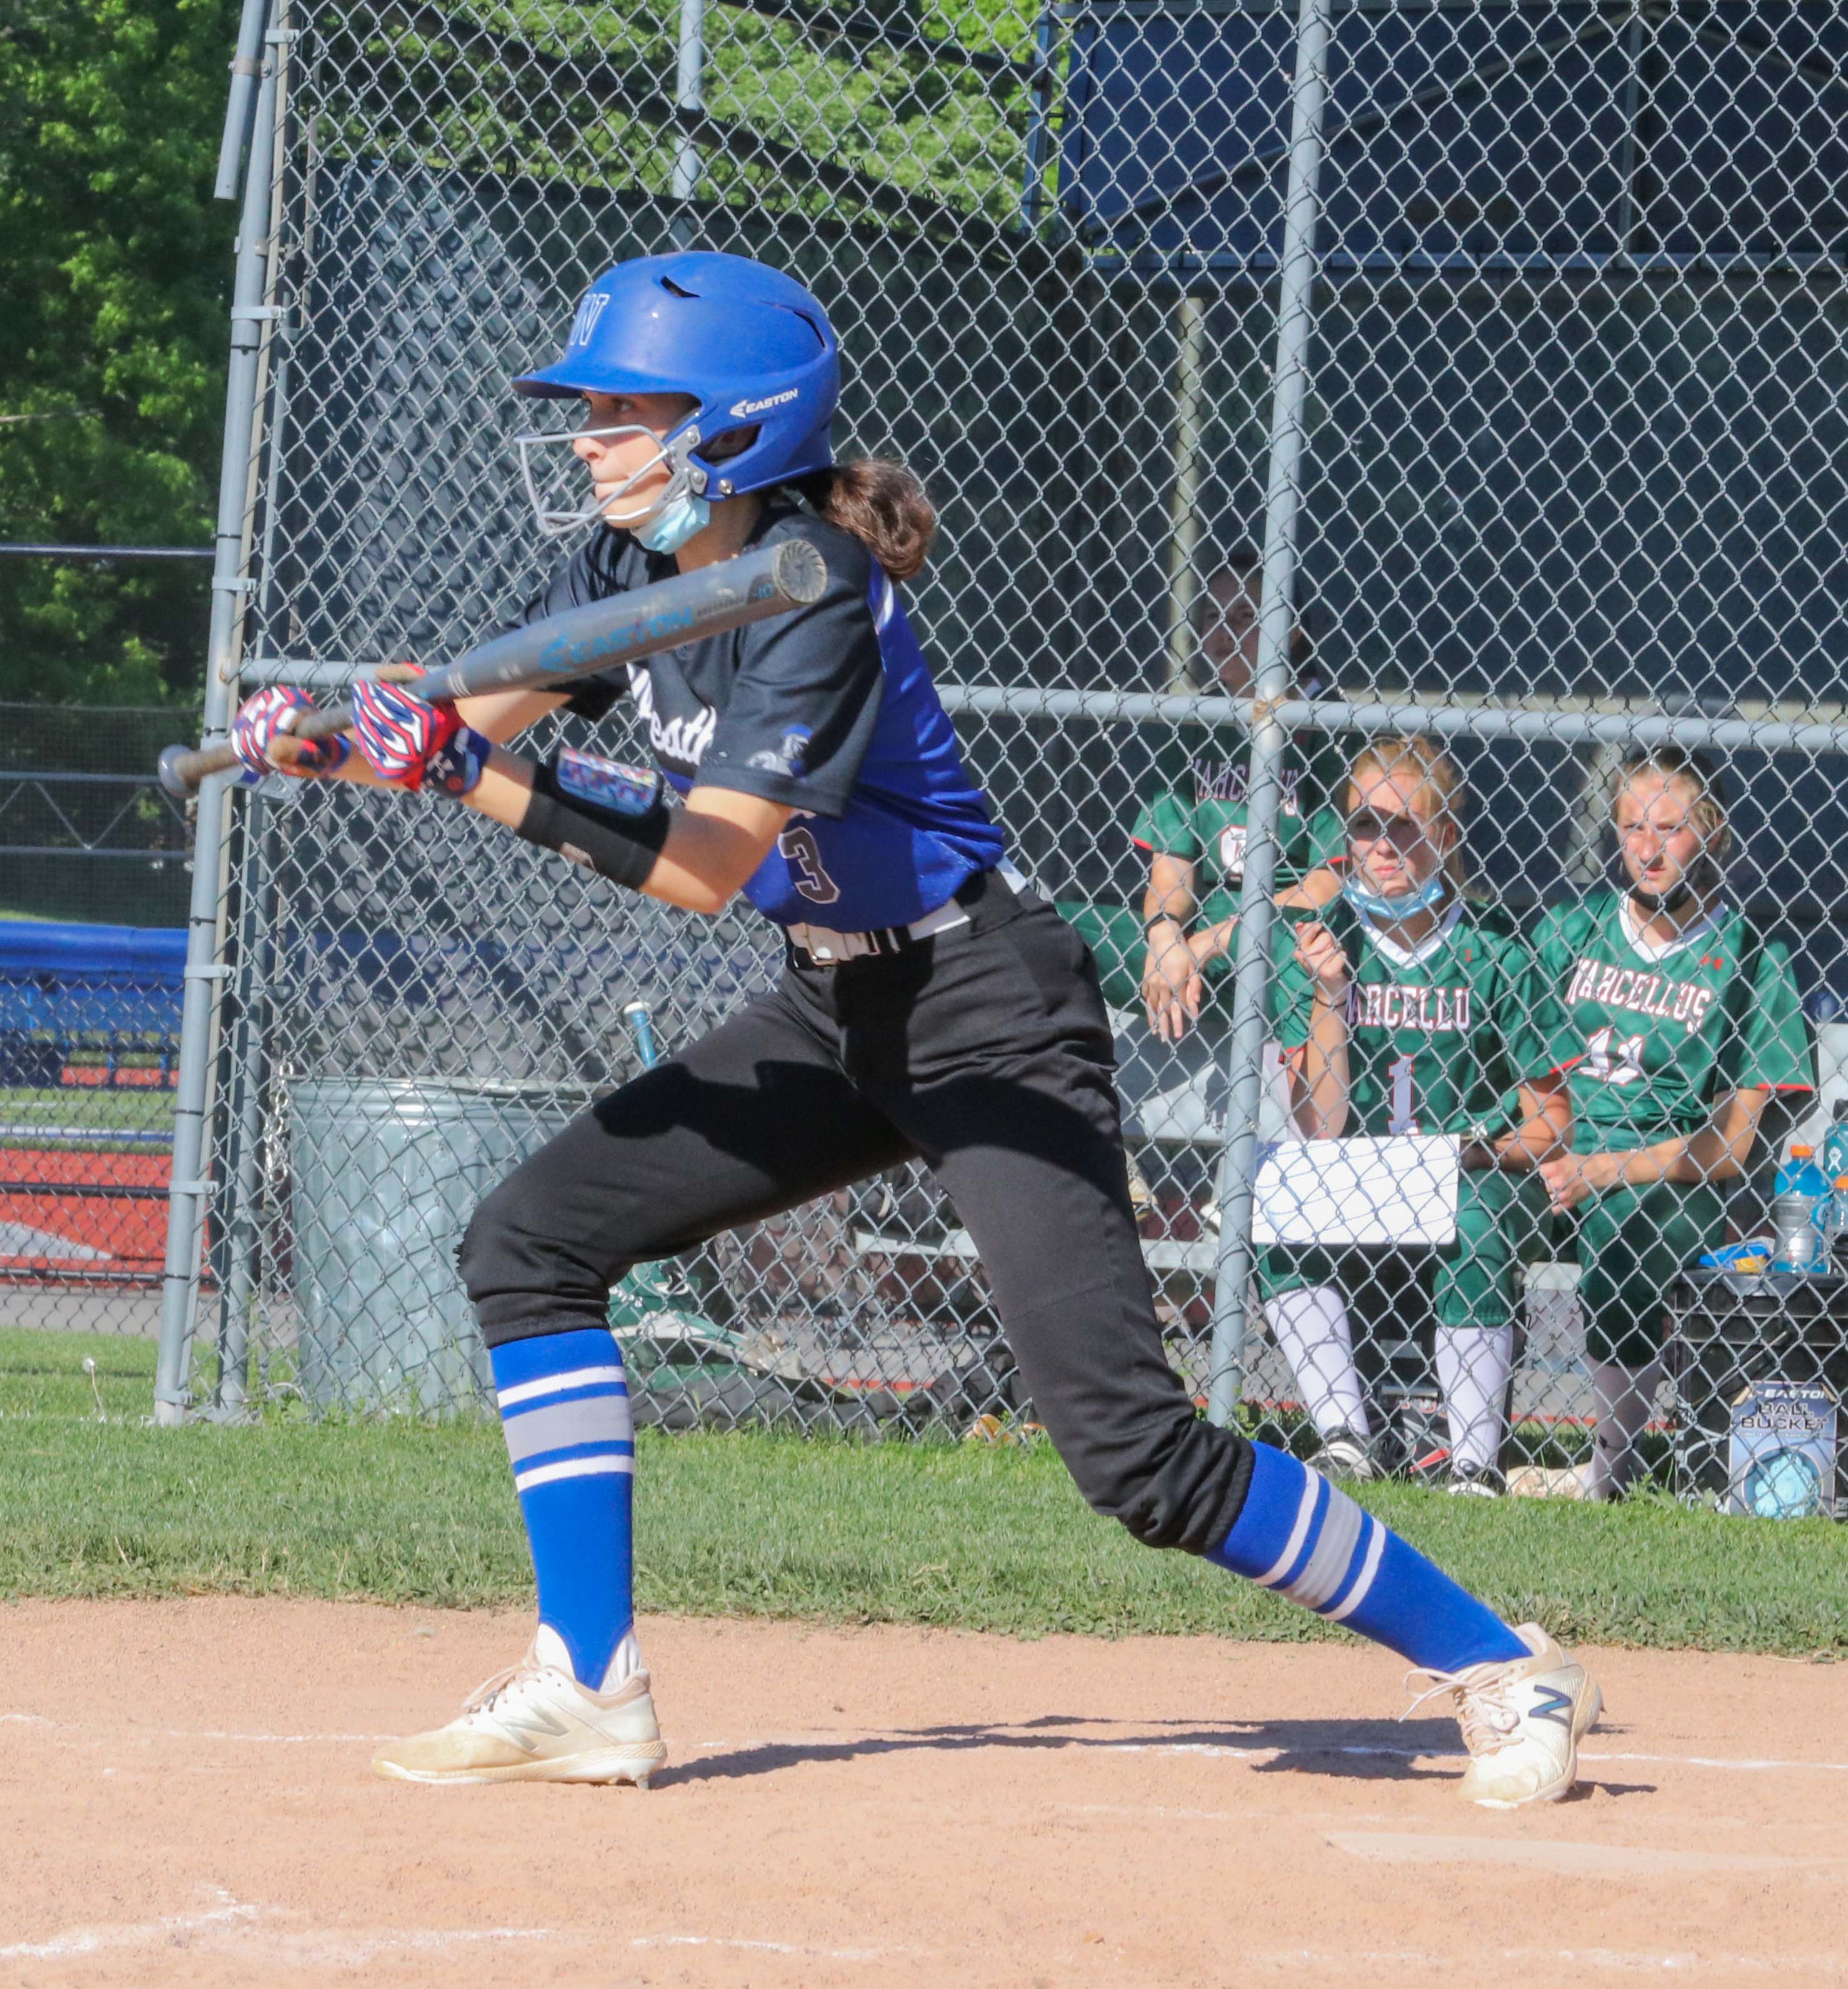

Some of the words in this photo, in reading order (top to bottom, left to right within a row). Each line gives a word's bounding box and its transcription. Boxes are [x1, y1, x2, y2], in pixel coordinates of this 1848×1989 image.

[745, 387, 799, 414] EASTON
[570, 605, 693, 665] EASTON
[777, 825, 841, 904] 3
[1578, 1027, 1645, 1087] 11
[1388, 1054, 1422, 1136] 1
